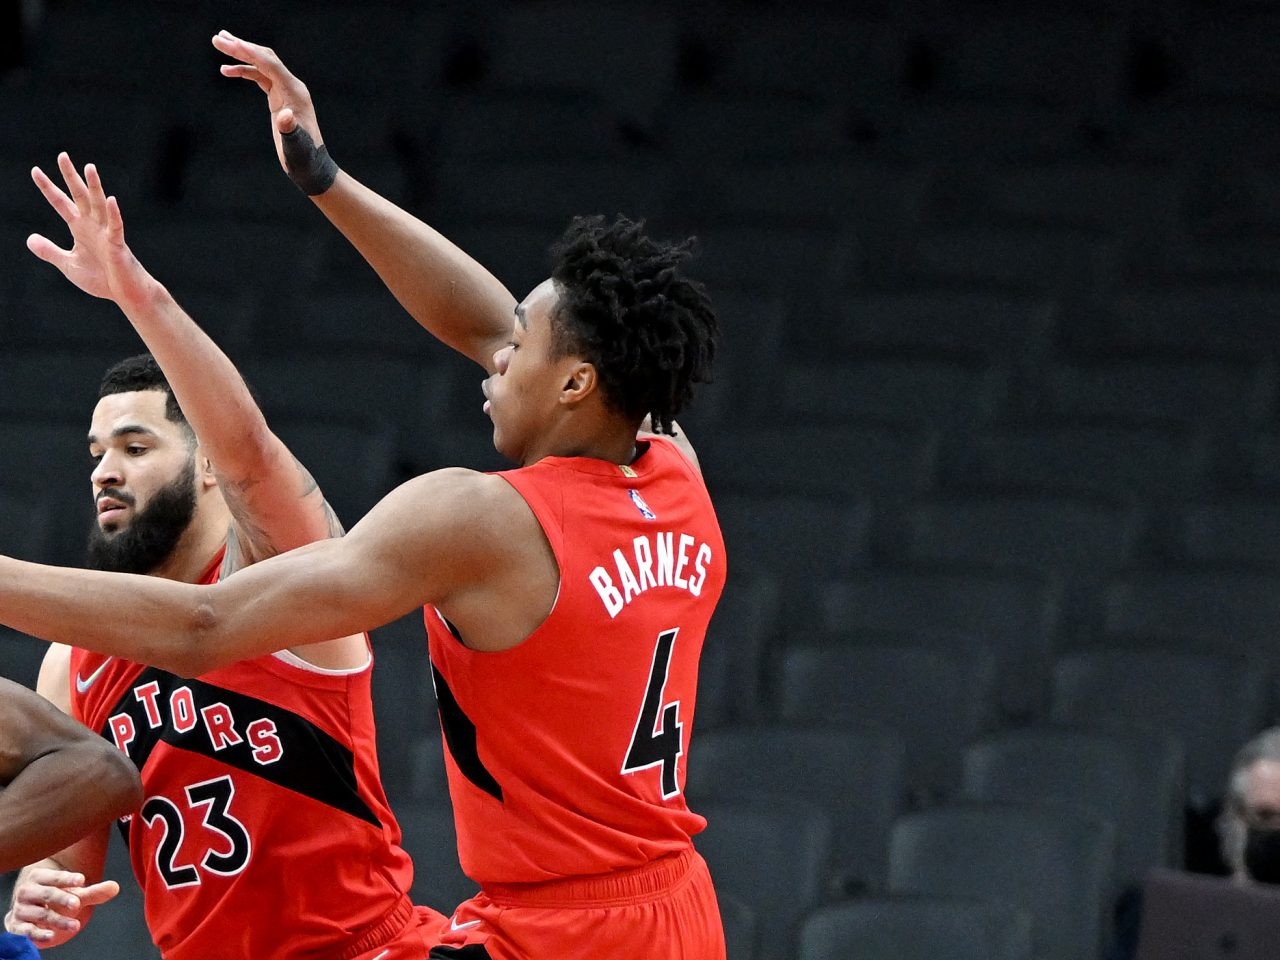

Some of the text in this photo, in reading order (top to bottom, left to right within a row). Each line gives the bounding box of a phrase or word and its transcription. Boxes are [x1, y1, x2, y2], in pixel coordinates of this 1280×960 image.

[589, 532, 712, 618] BARNES
[108, 680, 284, 765] PTORS
[621, 627, 683, 800] 4
[140, 775, 252, 890] 23
